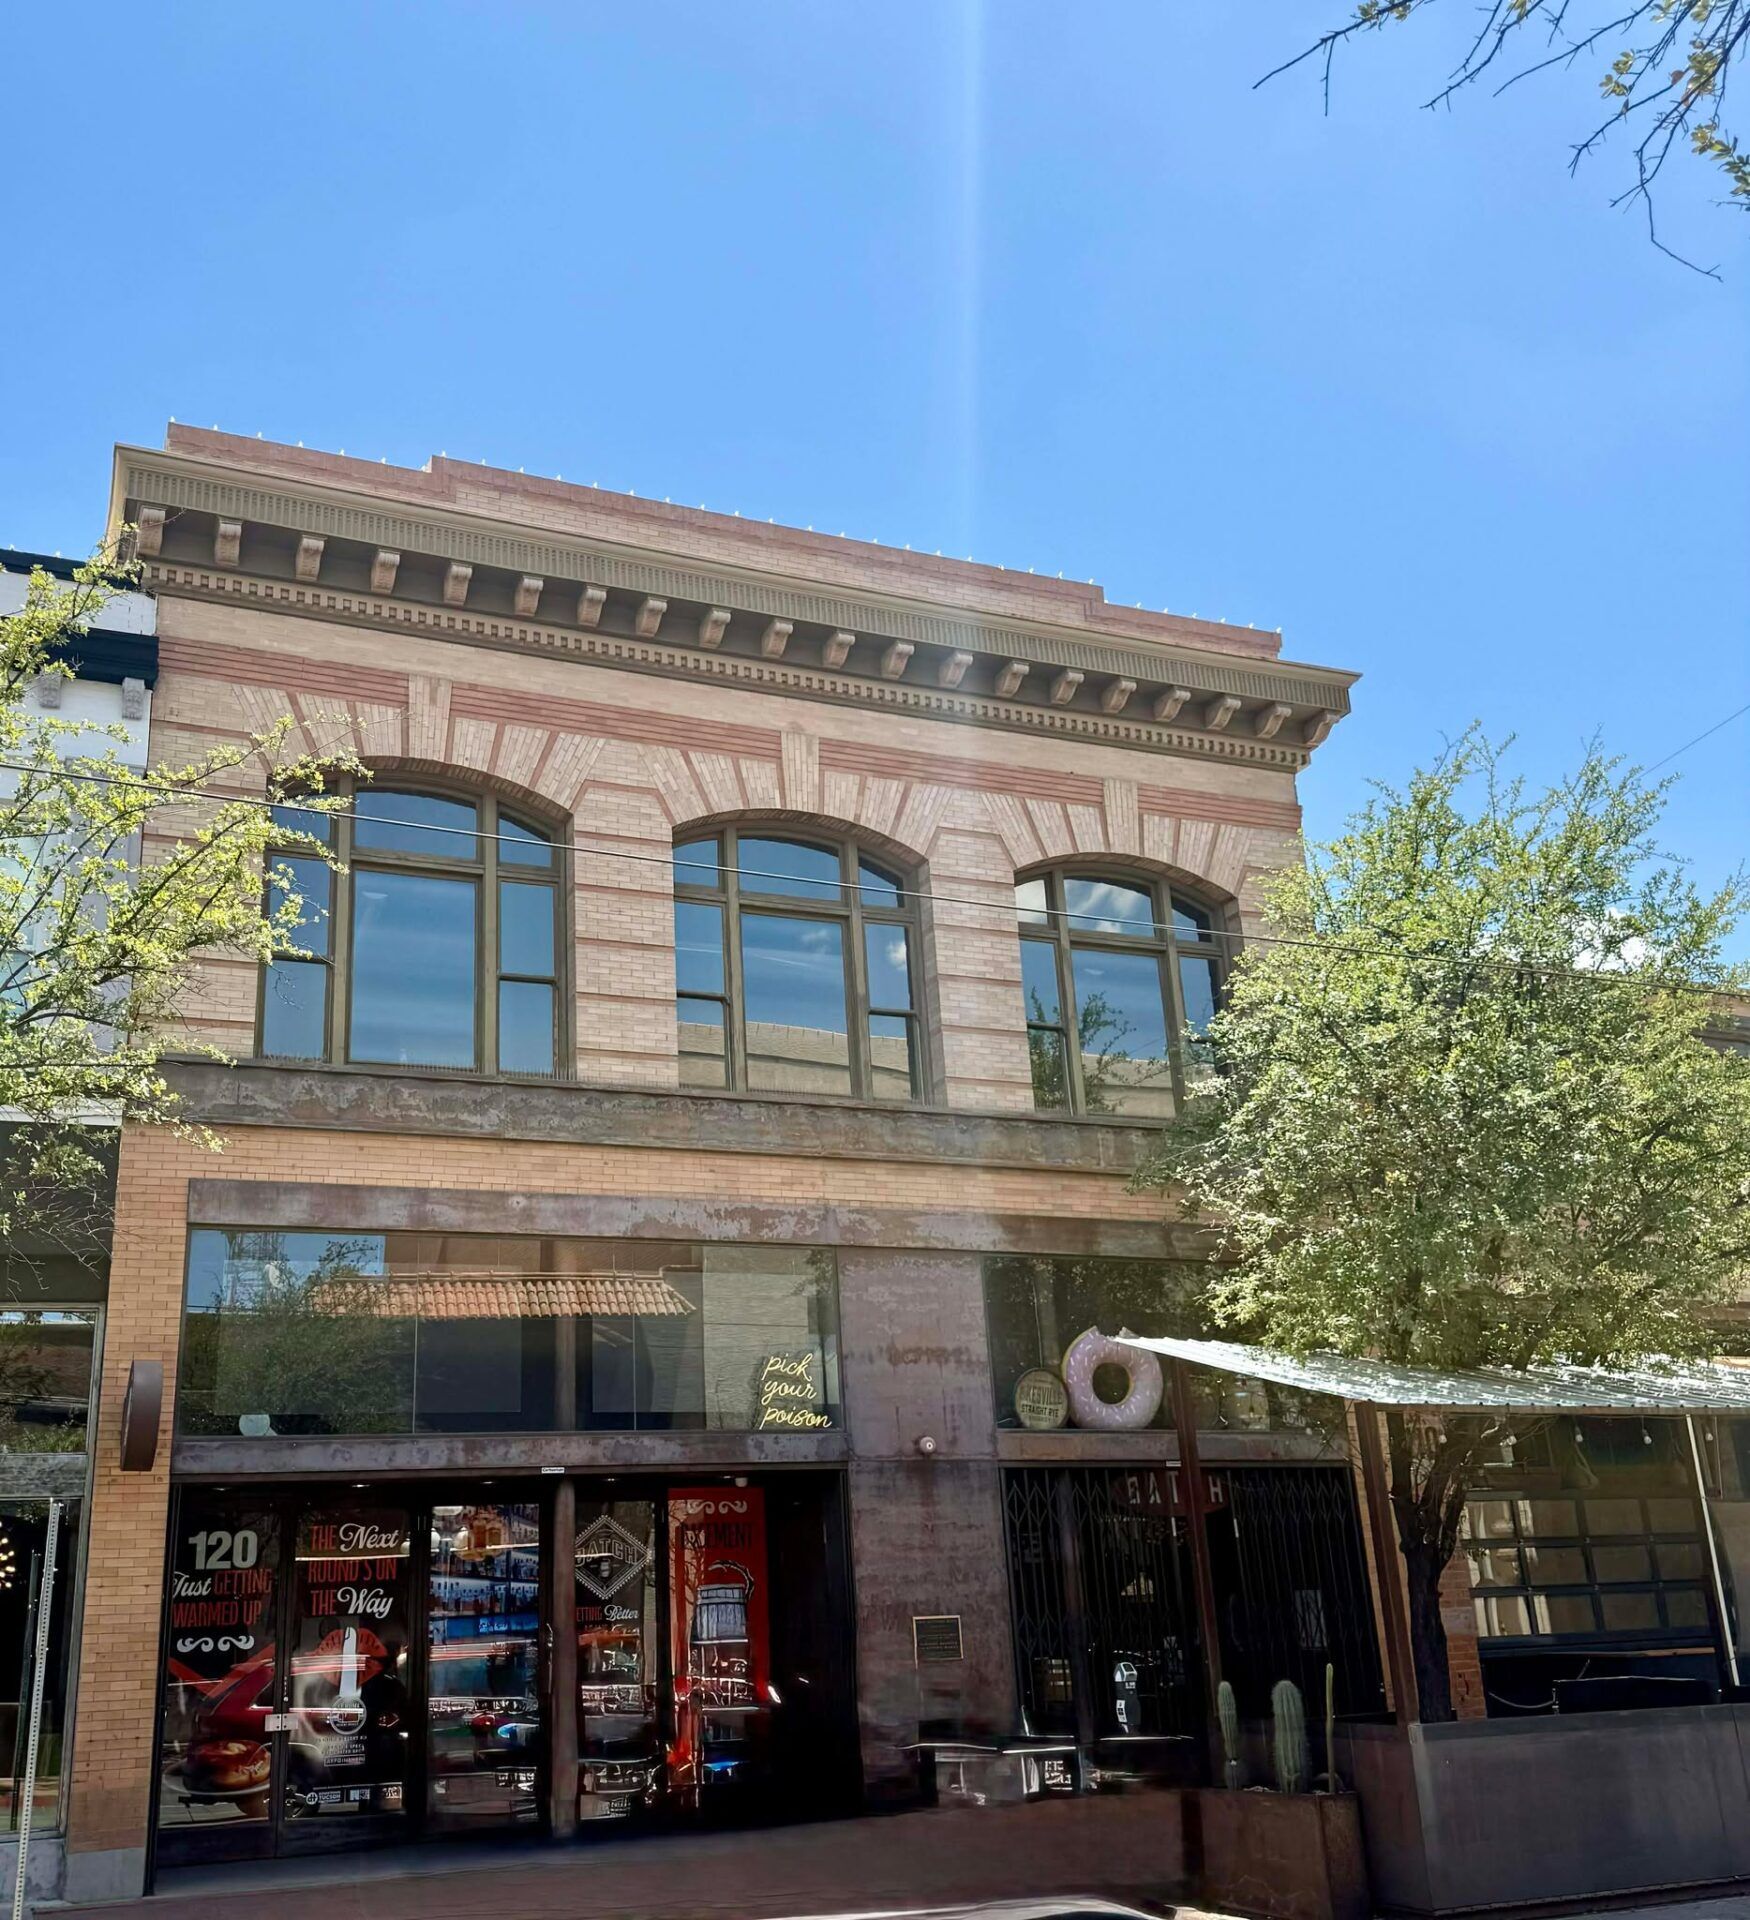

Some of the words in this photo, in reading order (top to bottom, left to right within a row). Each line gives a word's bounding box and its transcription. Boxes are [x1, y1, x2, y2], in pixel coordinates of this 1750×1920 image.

[761, 1353, 813, 1382] pick
[761, 1381, 817, 1405] your
[759, 1406, 832, 1430] poison
[1021, 1404, 1048, 1416] STRAIGHT
[1048, 1408, 1060, 1418] RYE
[1127, 1470, 1224, 1505] BATH
[187, 1530, 258, 1570] 120
[310, 1525, 337, 1552] THE
[339, 1523, 400, 1553] Next
[172, 1570, 212, 1598] Just
[214, 1568, 273, 1596] GETTING
[375, 1558, 398, 1581] ON
[172, 1600, 240, 1628] WARMED
[242, 1600, 262, 1626] UP
[310, 1590, 337, 1616] THE
[336, 1587, 394, 1619] Way
[575, 1605, 603, 1622] ETTING
[604, 1604, 639, 1621] Better
